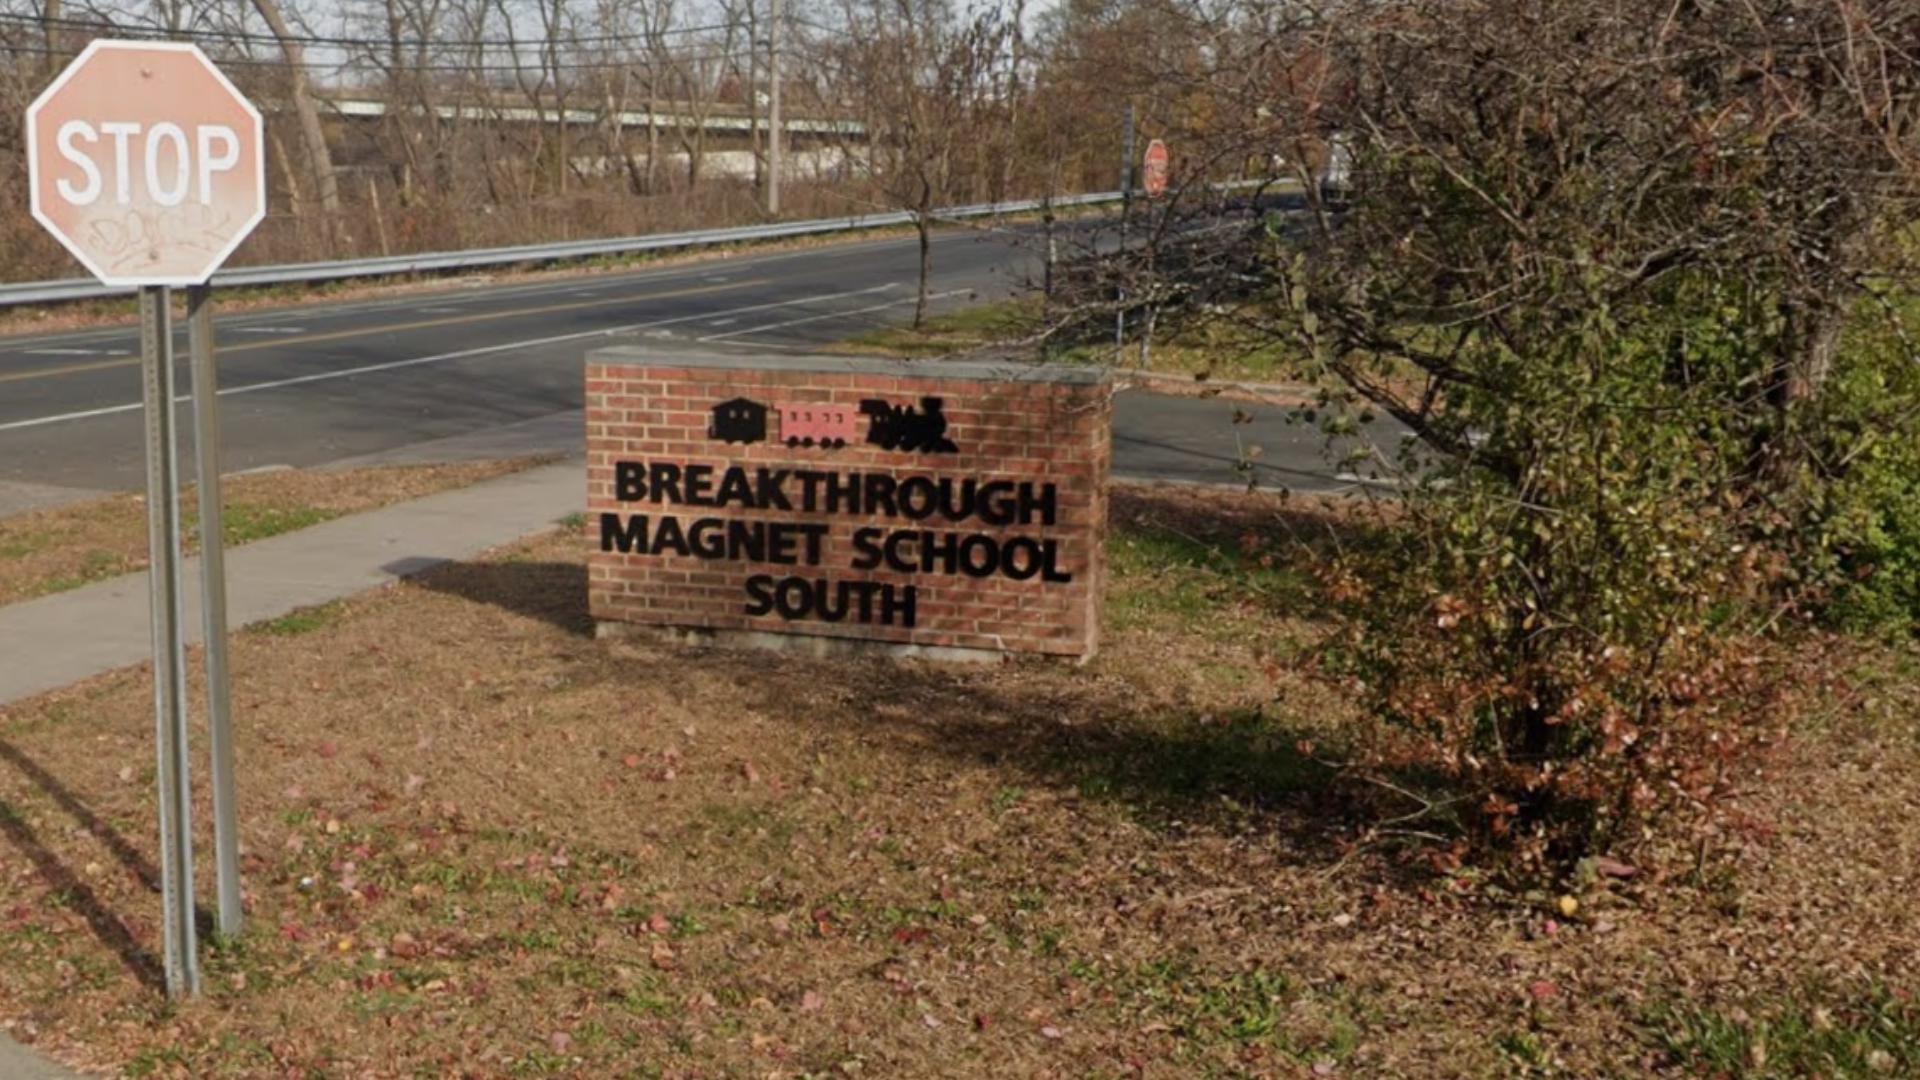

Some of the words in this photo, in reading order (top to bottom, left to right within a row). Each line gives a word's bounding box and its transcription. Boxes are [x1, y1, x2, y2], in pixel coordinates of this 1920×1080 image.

[56, 119, 240, 206] STOP
[614, 461, 1057, 526] BREAKTHROUGH
[600, 513, 828, 566] MAGNET
[850, 527, 1072, 582] SCHOOL
[744, 575, 917, 628] SOUTH
